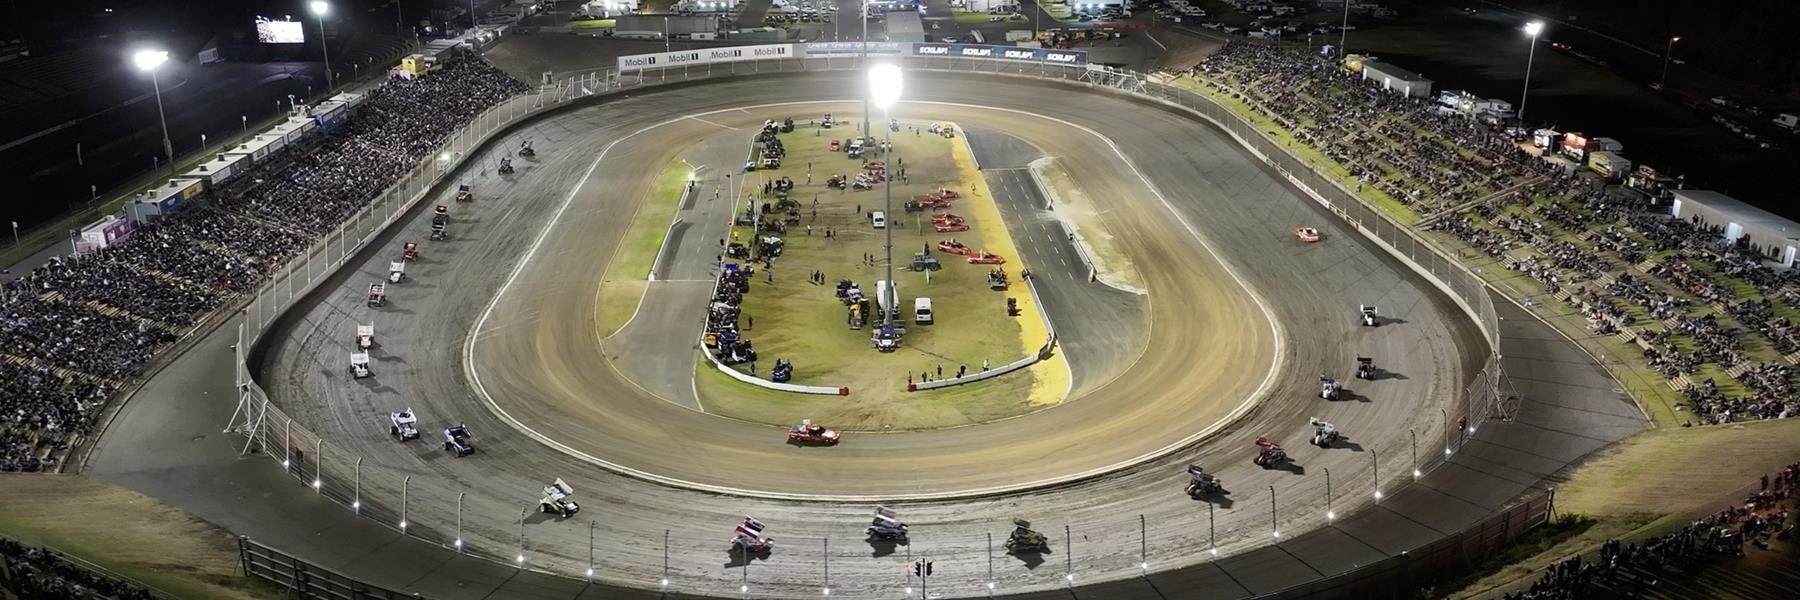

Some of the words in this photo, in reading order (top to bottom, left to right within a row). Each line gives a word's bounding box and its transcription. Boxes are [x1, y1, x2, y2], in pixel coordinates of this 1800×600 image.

[711, 49, 733, 59] Mobil
[754, 48, 776, 56] Mobil
[624, 57, 648, 67] Mobil
[668, 53, 690, 63] Mobil
